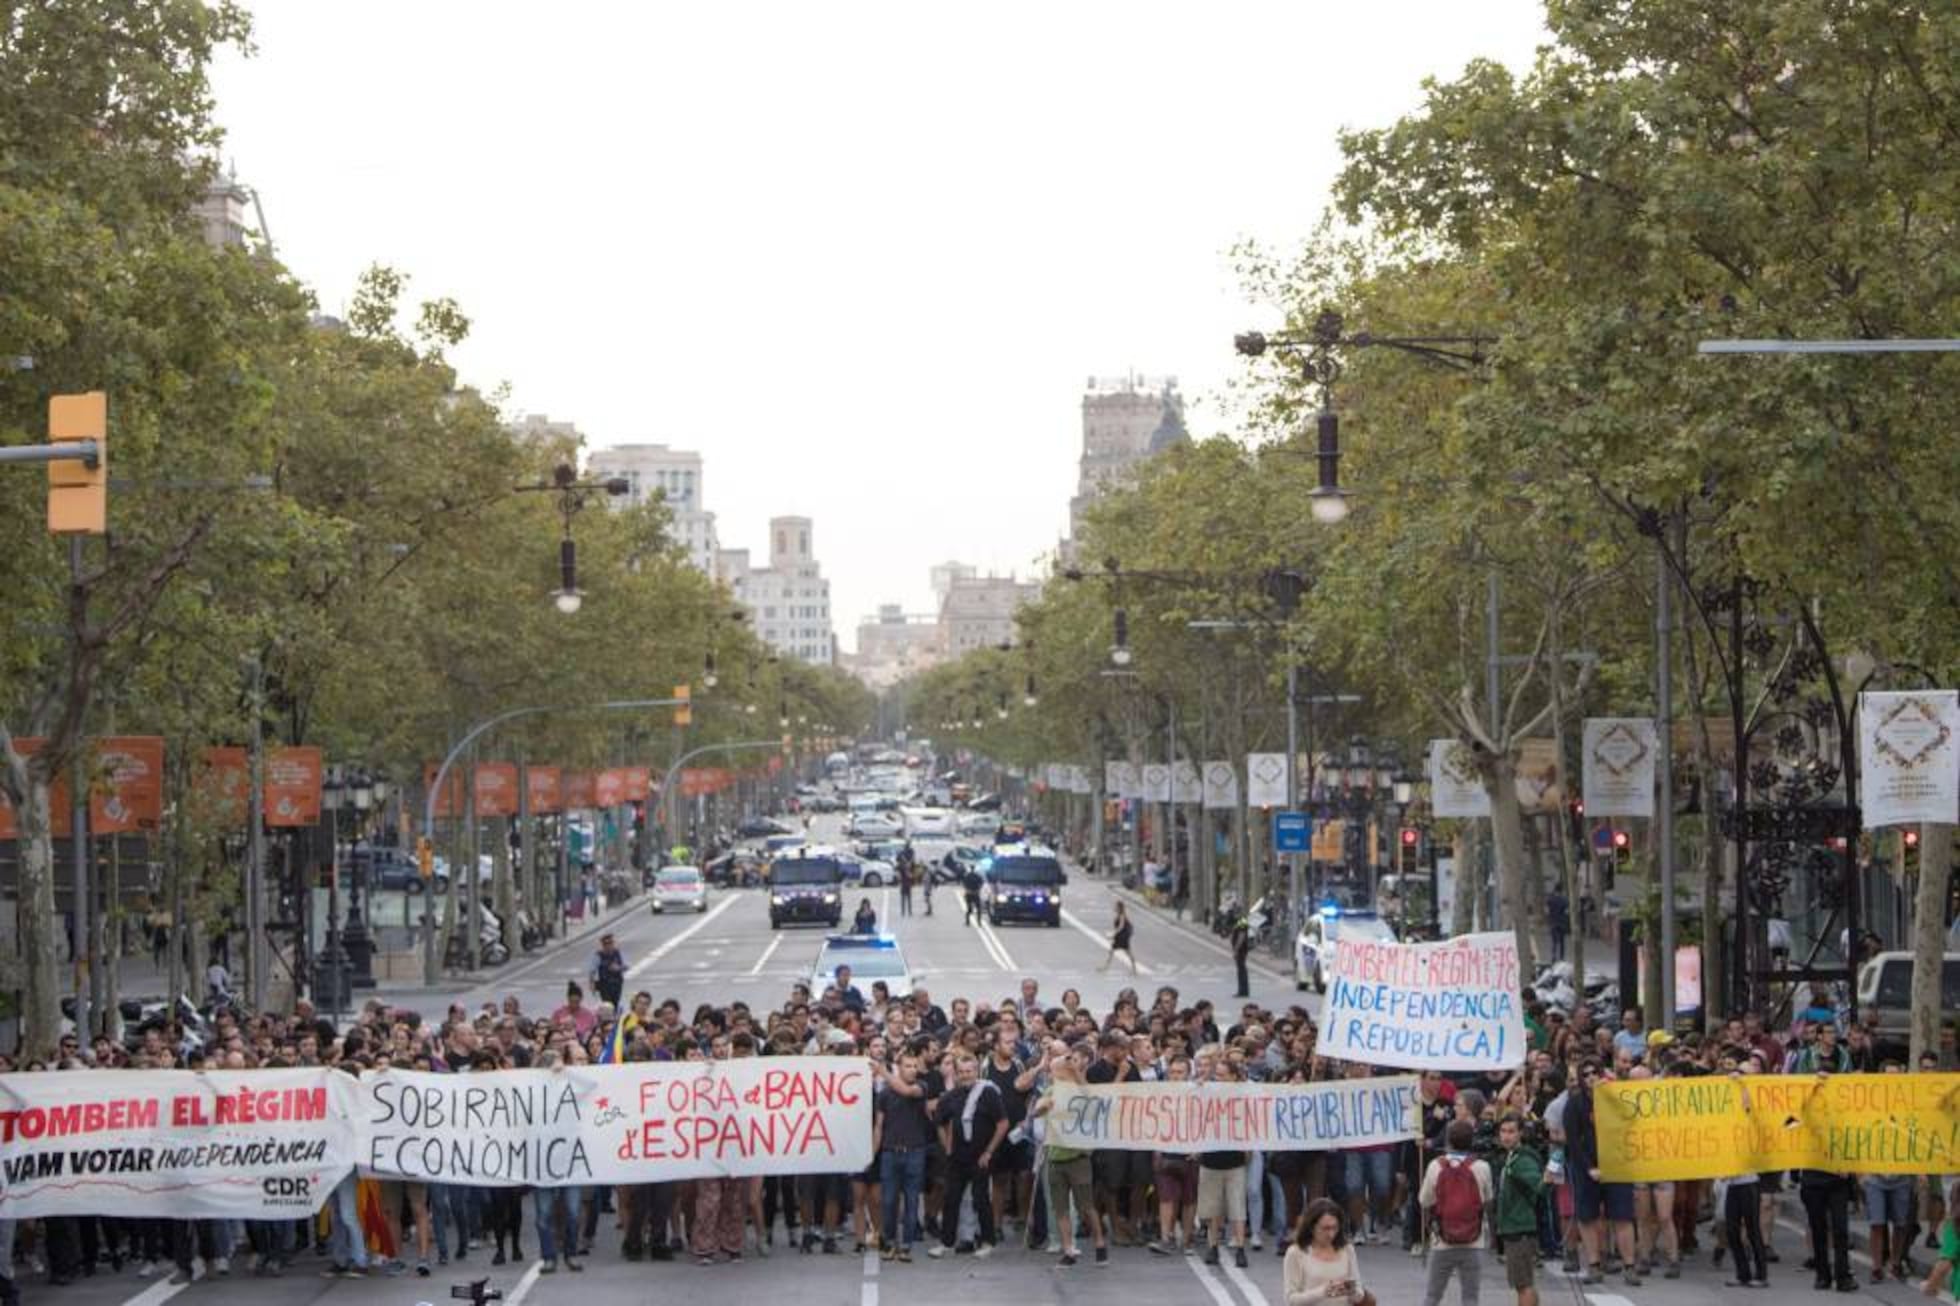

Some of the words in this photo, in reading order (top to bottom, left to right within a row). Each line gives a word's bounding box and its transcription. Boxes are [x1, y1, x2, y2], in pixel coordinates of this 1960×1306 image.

[0, 1099, 159, 1142] TOMBEM
[173, 1096, 208, 1126] EL
[216, 1086, 327, 1124] RÈGIM
[371, 1082, 581, 1128] SOBIRANIA
[639, 1076, 739, 1114] FORA
[765, 1070, 862, 1111] BANC
[4, 1152, 64, 1185] VAM
[70, 1148, 154, 1174] VOTAR
[157, 1137, 327, 1169] INDEPENDÈNCIA
[371, 1134, 593, 1180] ECONÒMICA
[263, 1177, 310, 1195] CDR
